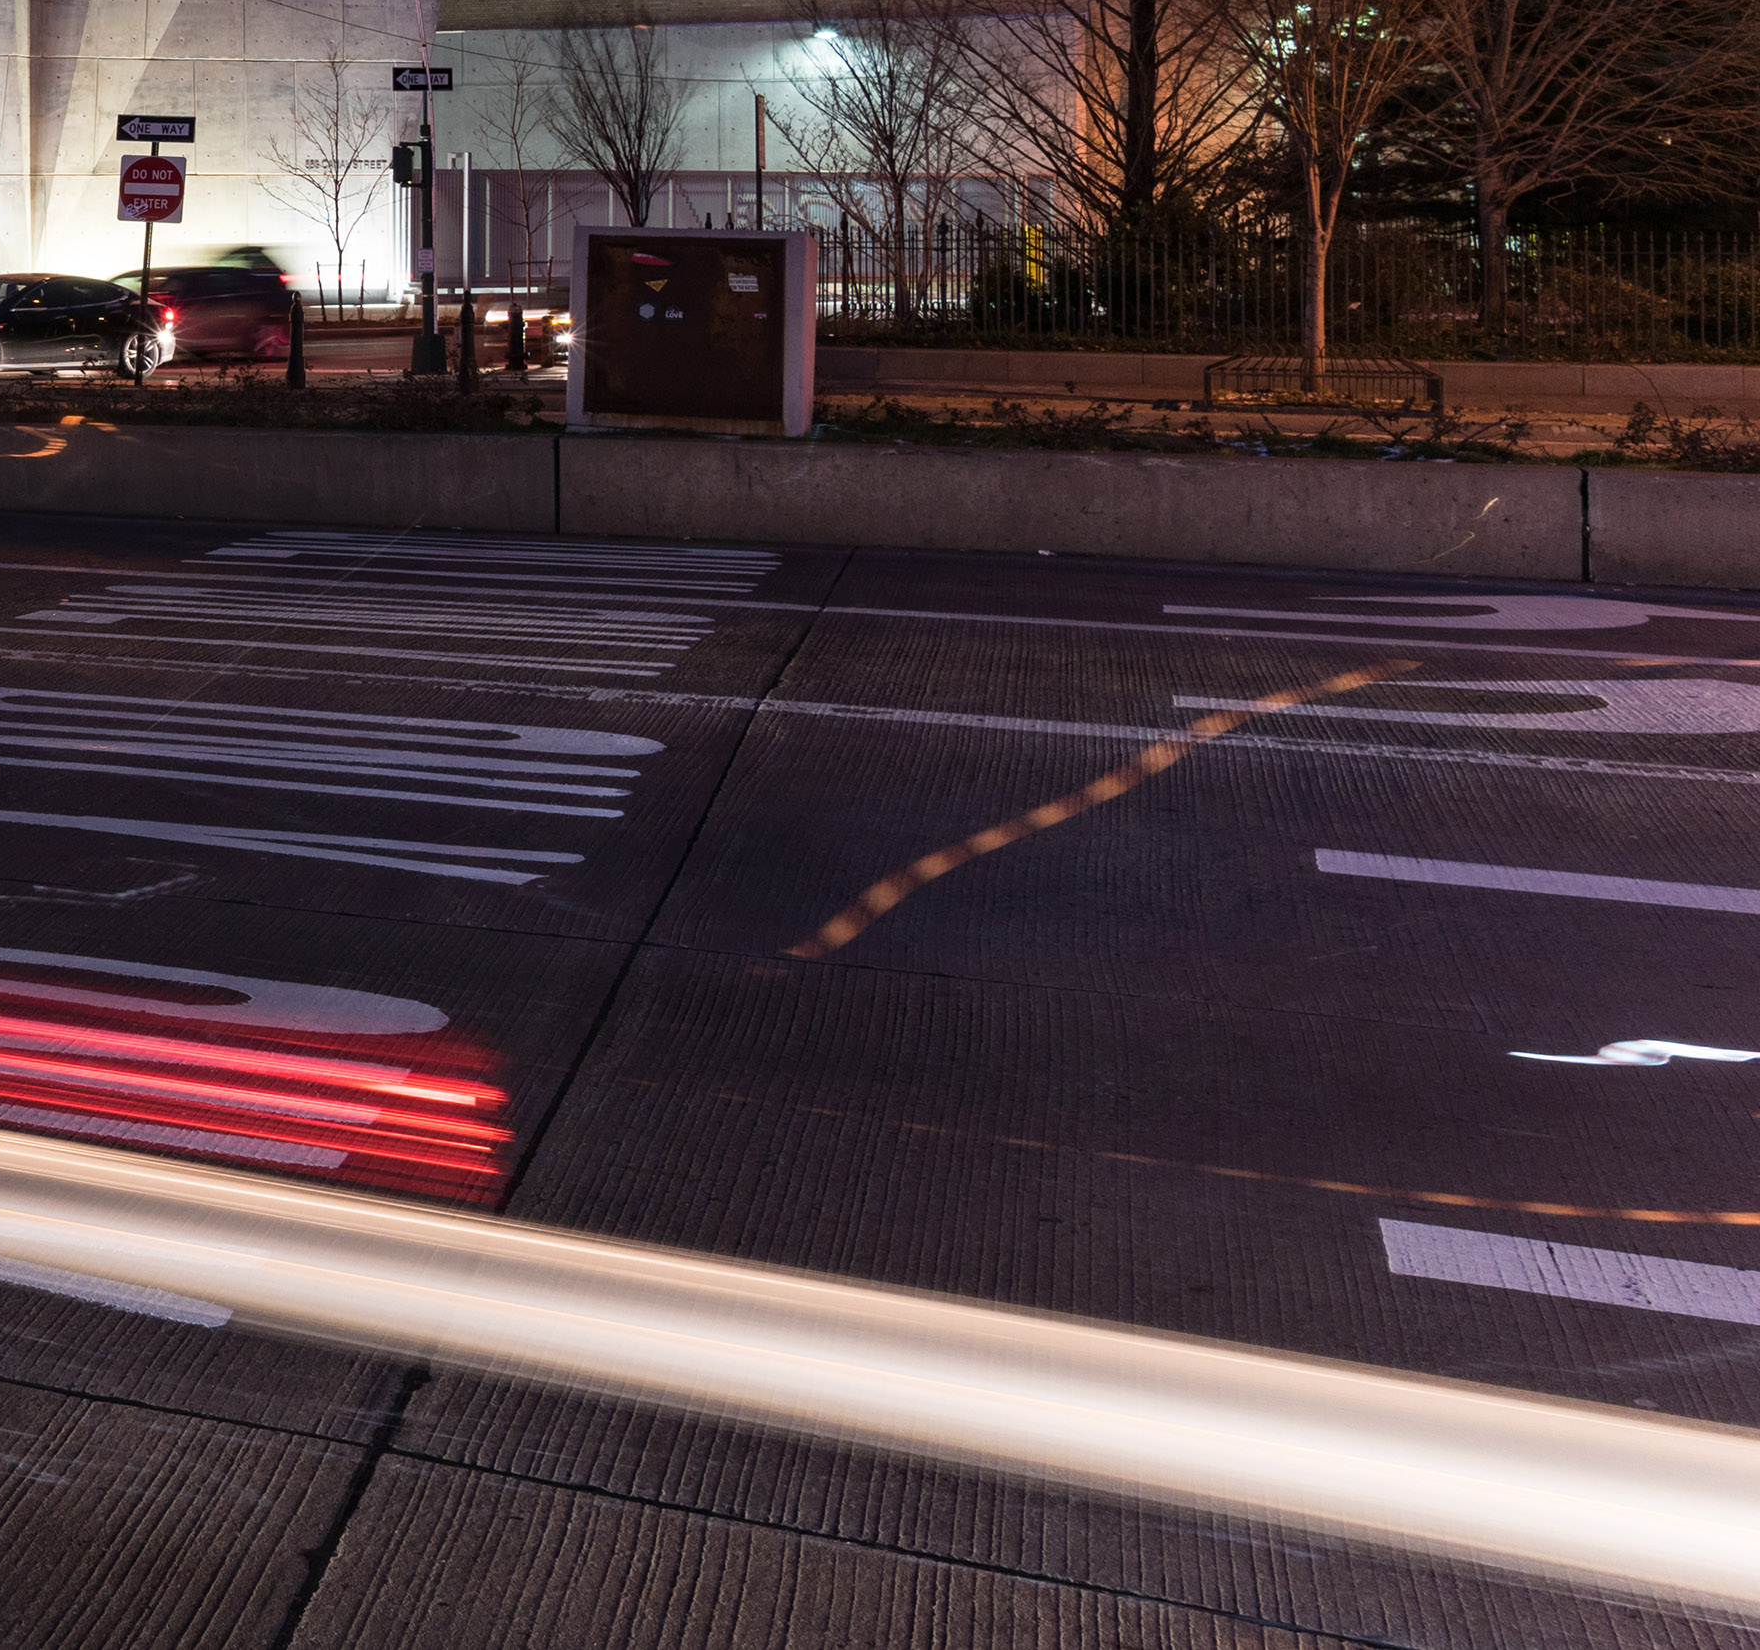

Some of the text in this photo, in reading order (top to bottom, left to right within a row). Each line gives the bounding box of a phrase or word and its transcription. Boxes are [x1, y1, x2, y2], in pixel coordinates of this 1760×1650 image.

[402, 74, 419, 84] ONE
[129, 123, 185, 134] ONE WAY
[353, 159, 387, 169] STREET
[132, 168, 173, 180] DO NOT
[133, 198, 168, 209] ENTER
